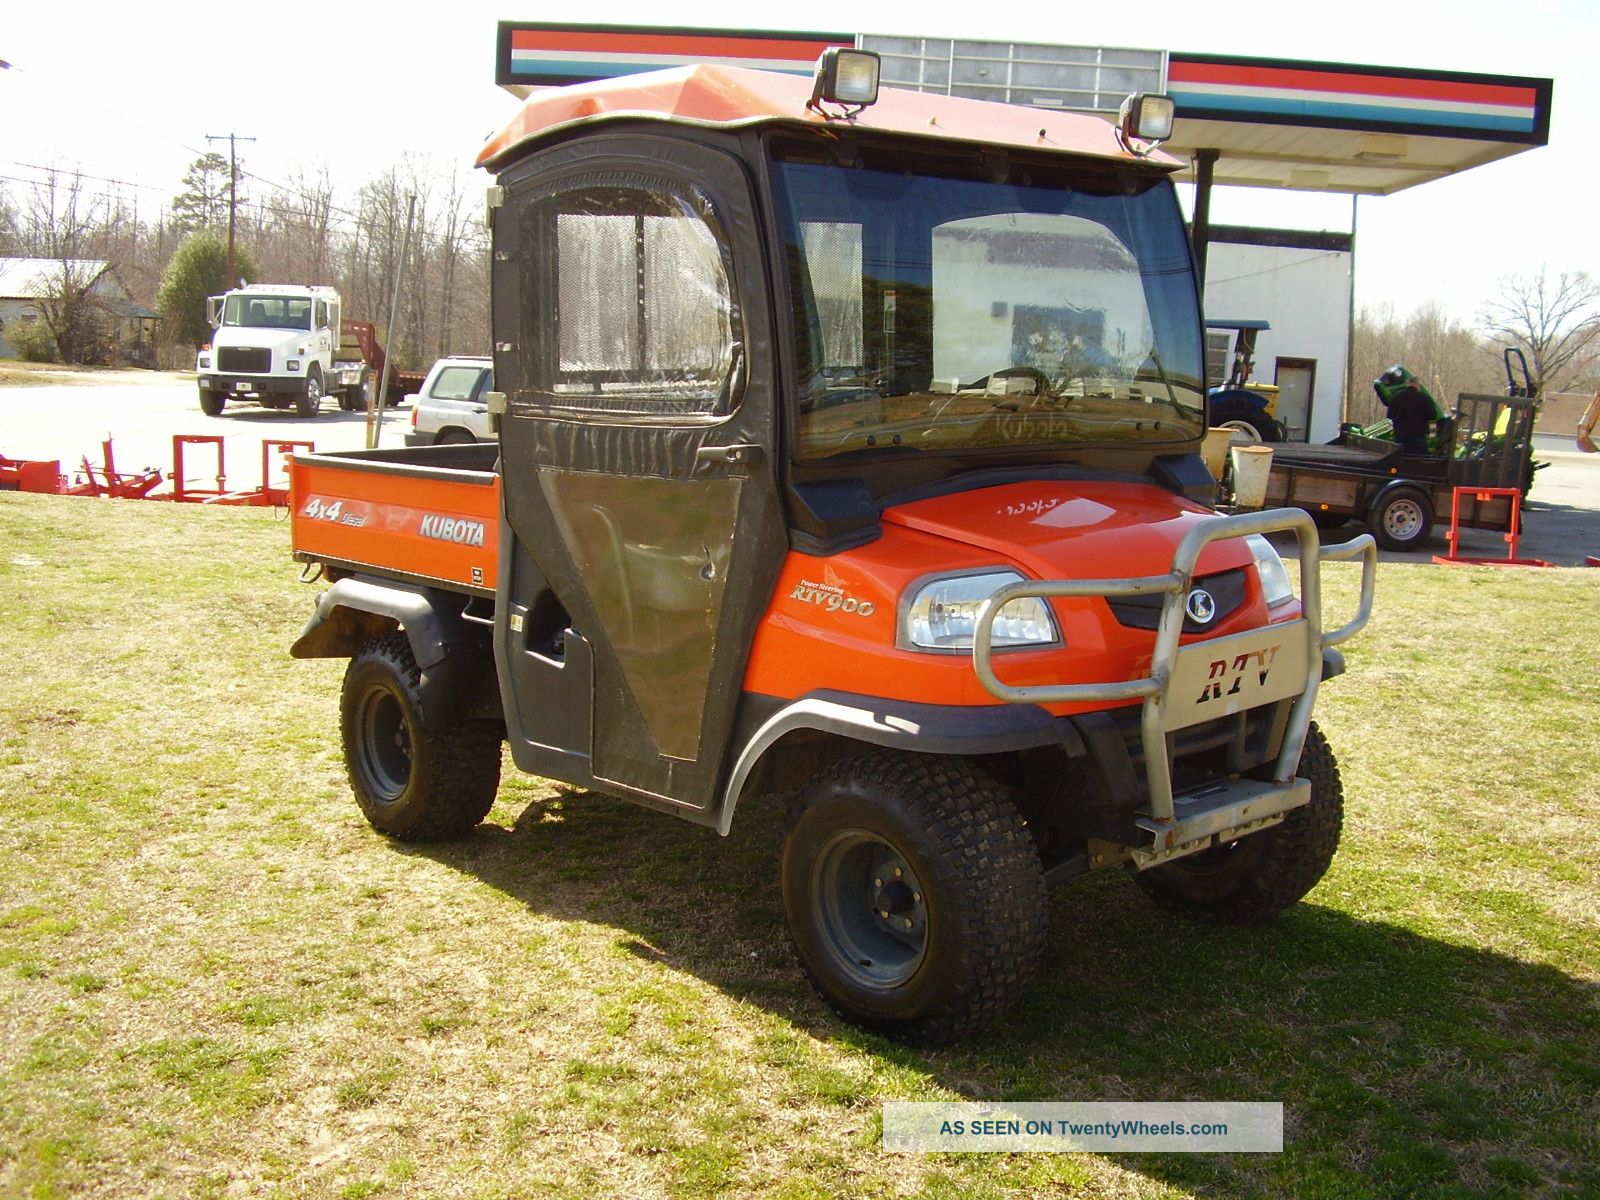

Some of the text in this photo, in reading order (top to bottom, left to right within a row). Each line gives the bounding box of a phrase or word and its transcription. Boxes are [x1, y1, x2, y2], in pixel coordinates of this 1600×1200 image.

[304, 498, 342, 521] 4x4
[419, 514, 484, 547] KUBOTA
[790, 584, 875, 617] RTV900
[1195, 645, 1281, 705] RTV
